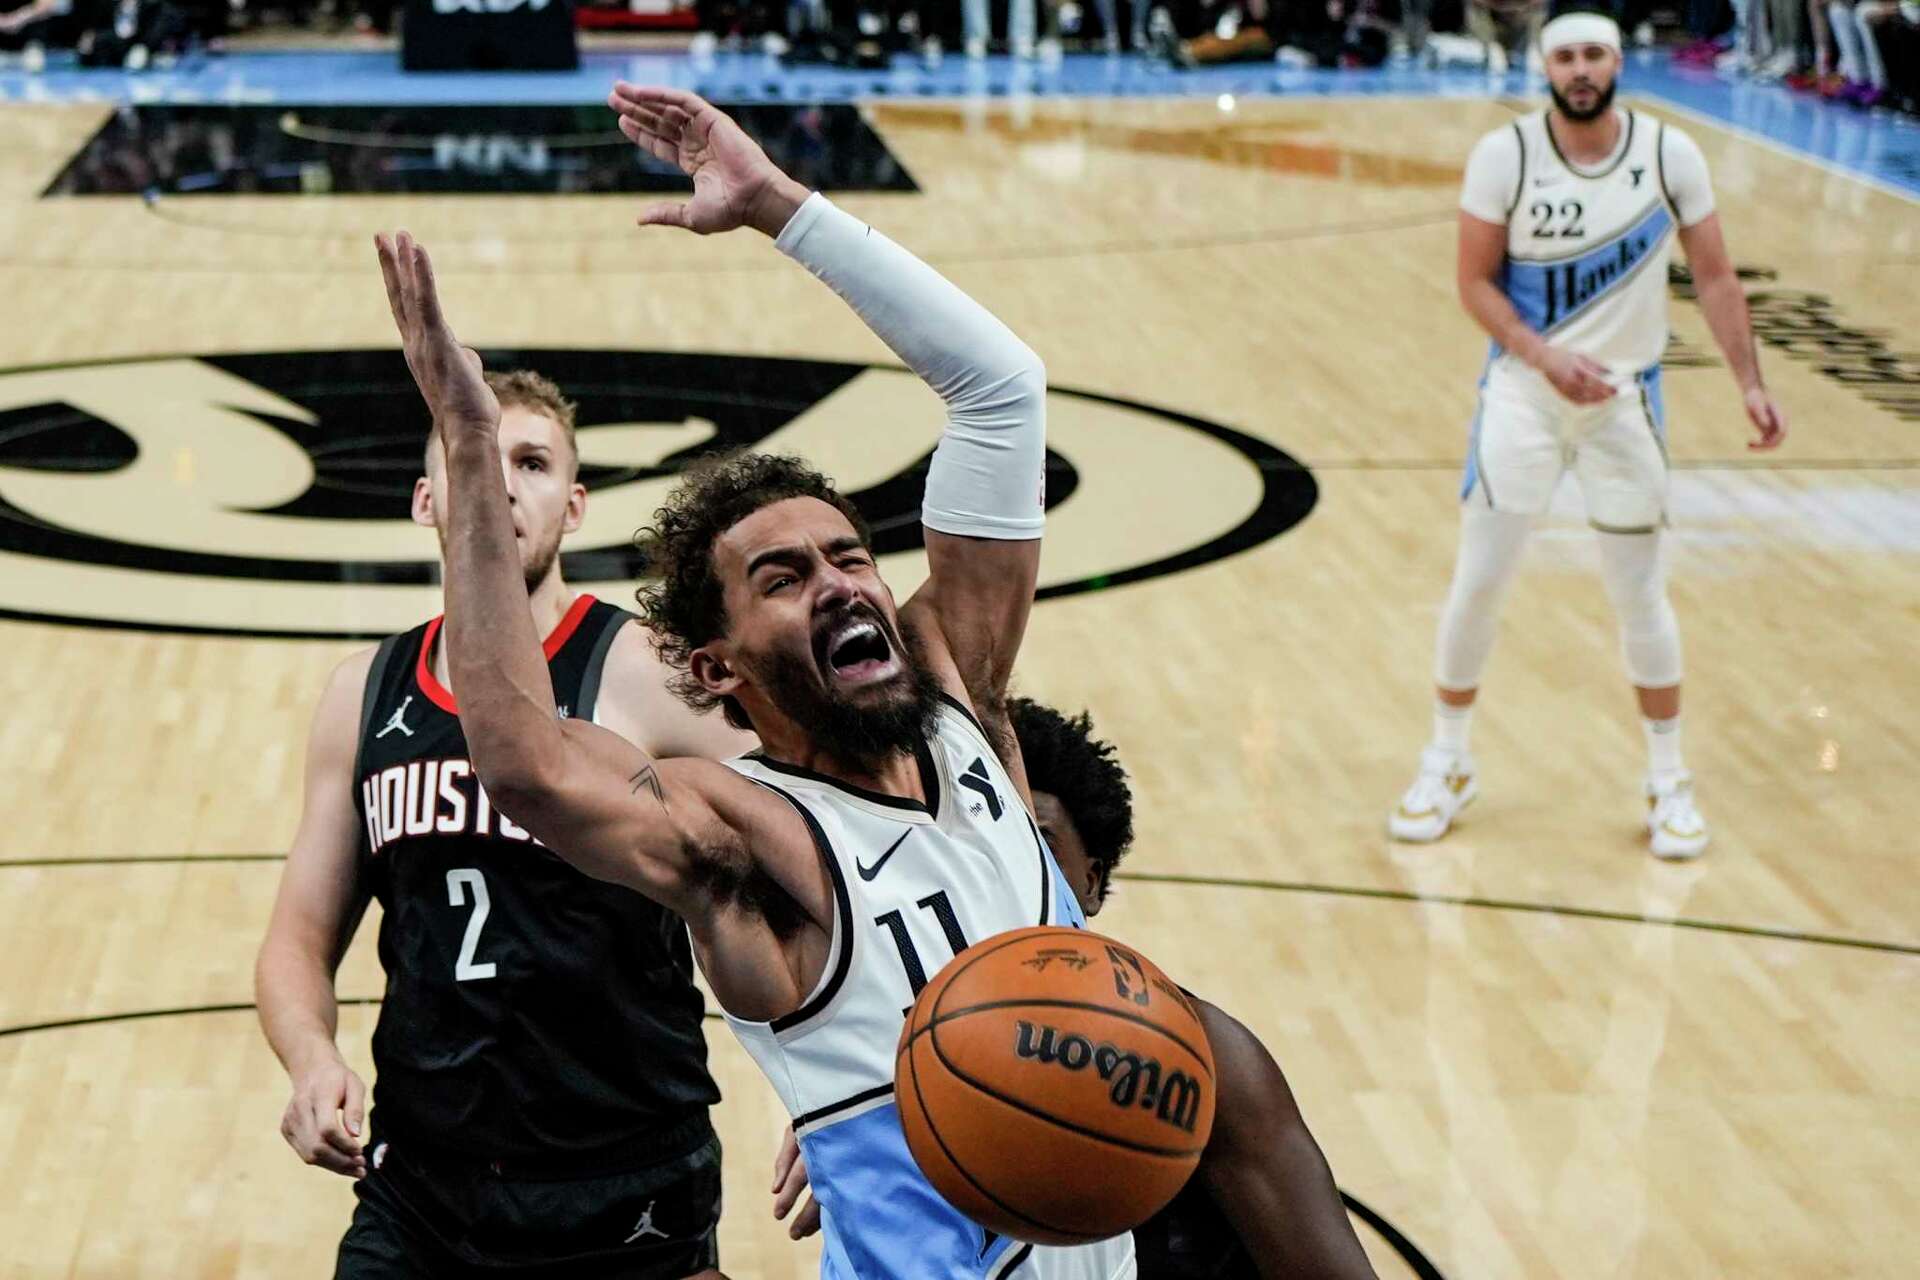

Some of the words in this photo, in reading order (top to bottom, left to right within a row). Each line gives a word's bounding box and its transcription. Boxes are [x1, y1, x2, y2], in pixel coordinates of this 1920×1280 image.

[1530, 201, 1585, 238] 22
[1544, 237, 1647, 328] Hawks
[446, 868, 497, 981] 2
[873, 888, 970, 1020] 11
[1014, 1019, 1201, 1136] Wilson
